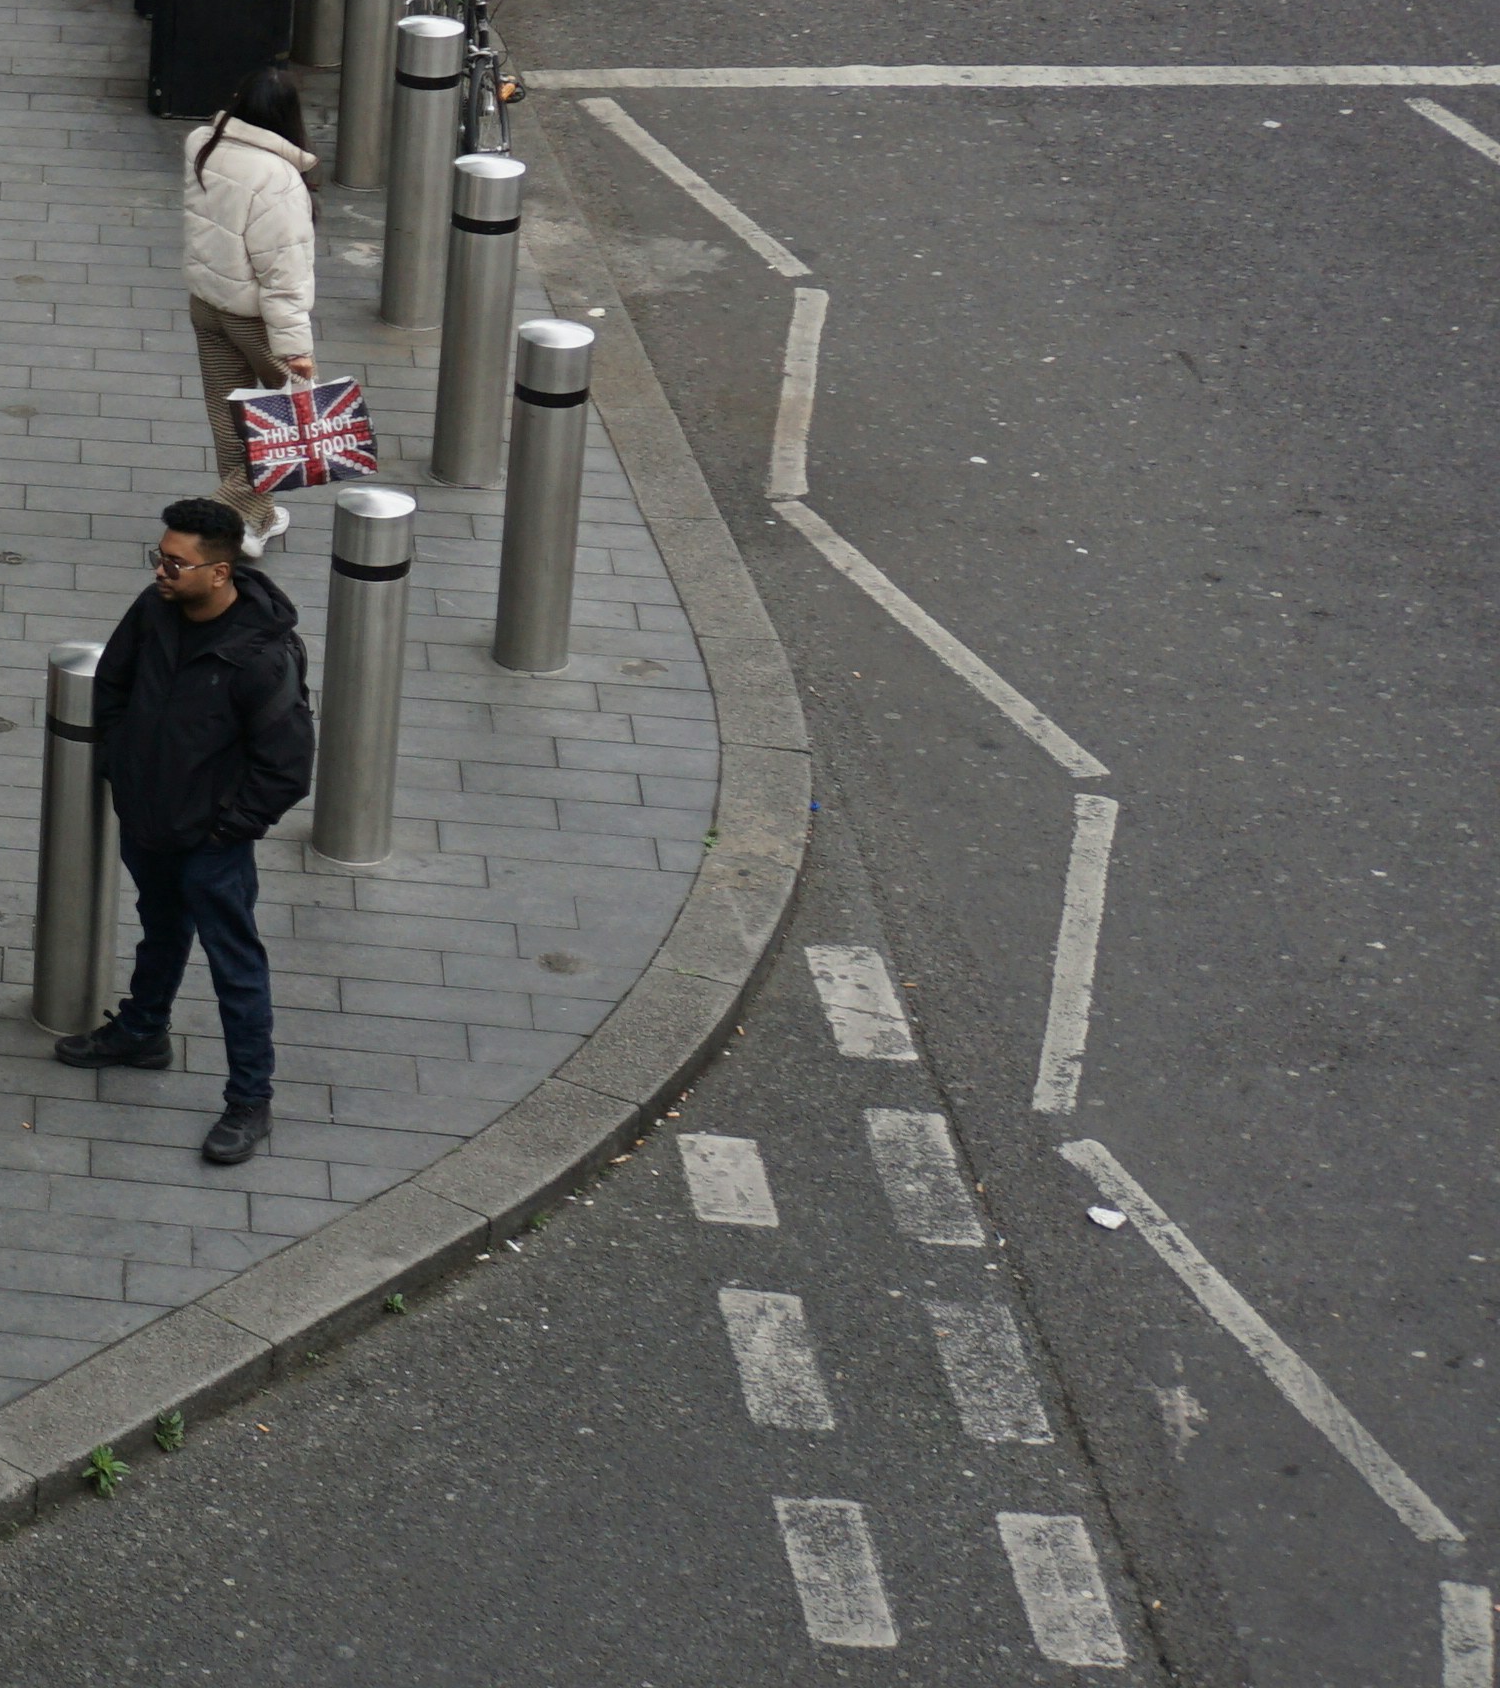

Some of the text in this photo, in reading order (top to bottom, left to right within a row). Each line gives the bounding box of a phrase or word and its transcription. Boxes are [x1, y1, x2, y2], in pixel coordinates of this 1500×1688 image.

[263, 414, 352, 445] THIS IS NOT
[265, 433, 358, 461] JUST FOOD
